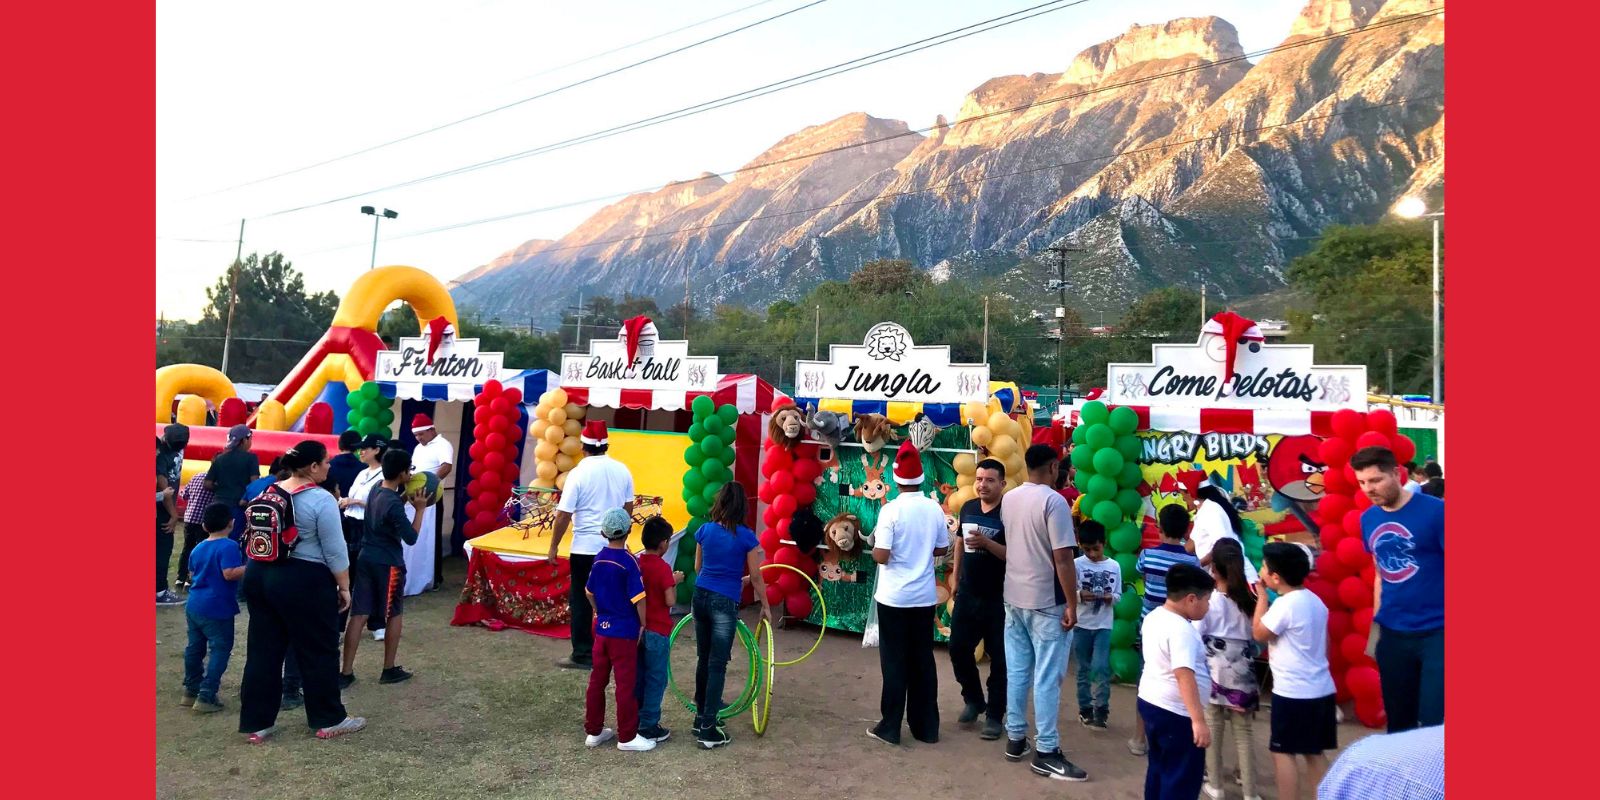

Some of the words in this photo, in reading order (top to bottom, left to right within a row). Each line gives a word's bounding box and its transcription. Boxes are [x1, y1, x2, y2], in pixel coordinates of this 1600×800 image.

[834, 366, 941, 398] Jungla
[1149, 365, 1217, 398] Come
[1139, 433, 1199, 462] NGRY
[1204, 432, 1269, 458] BIRDS
